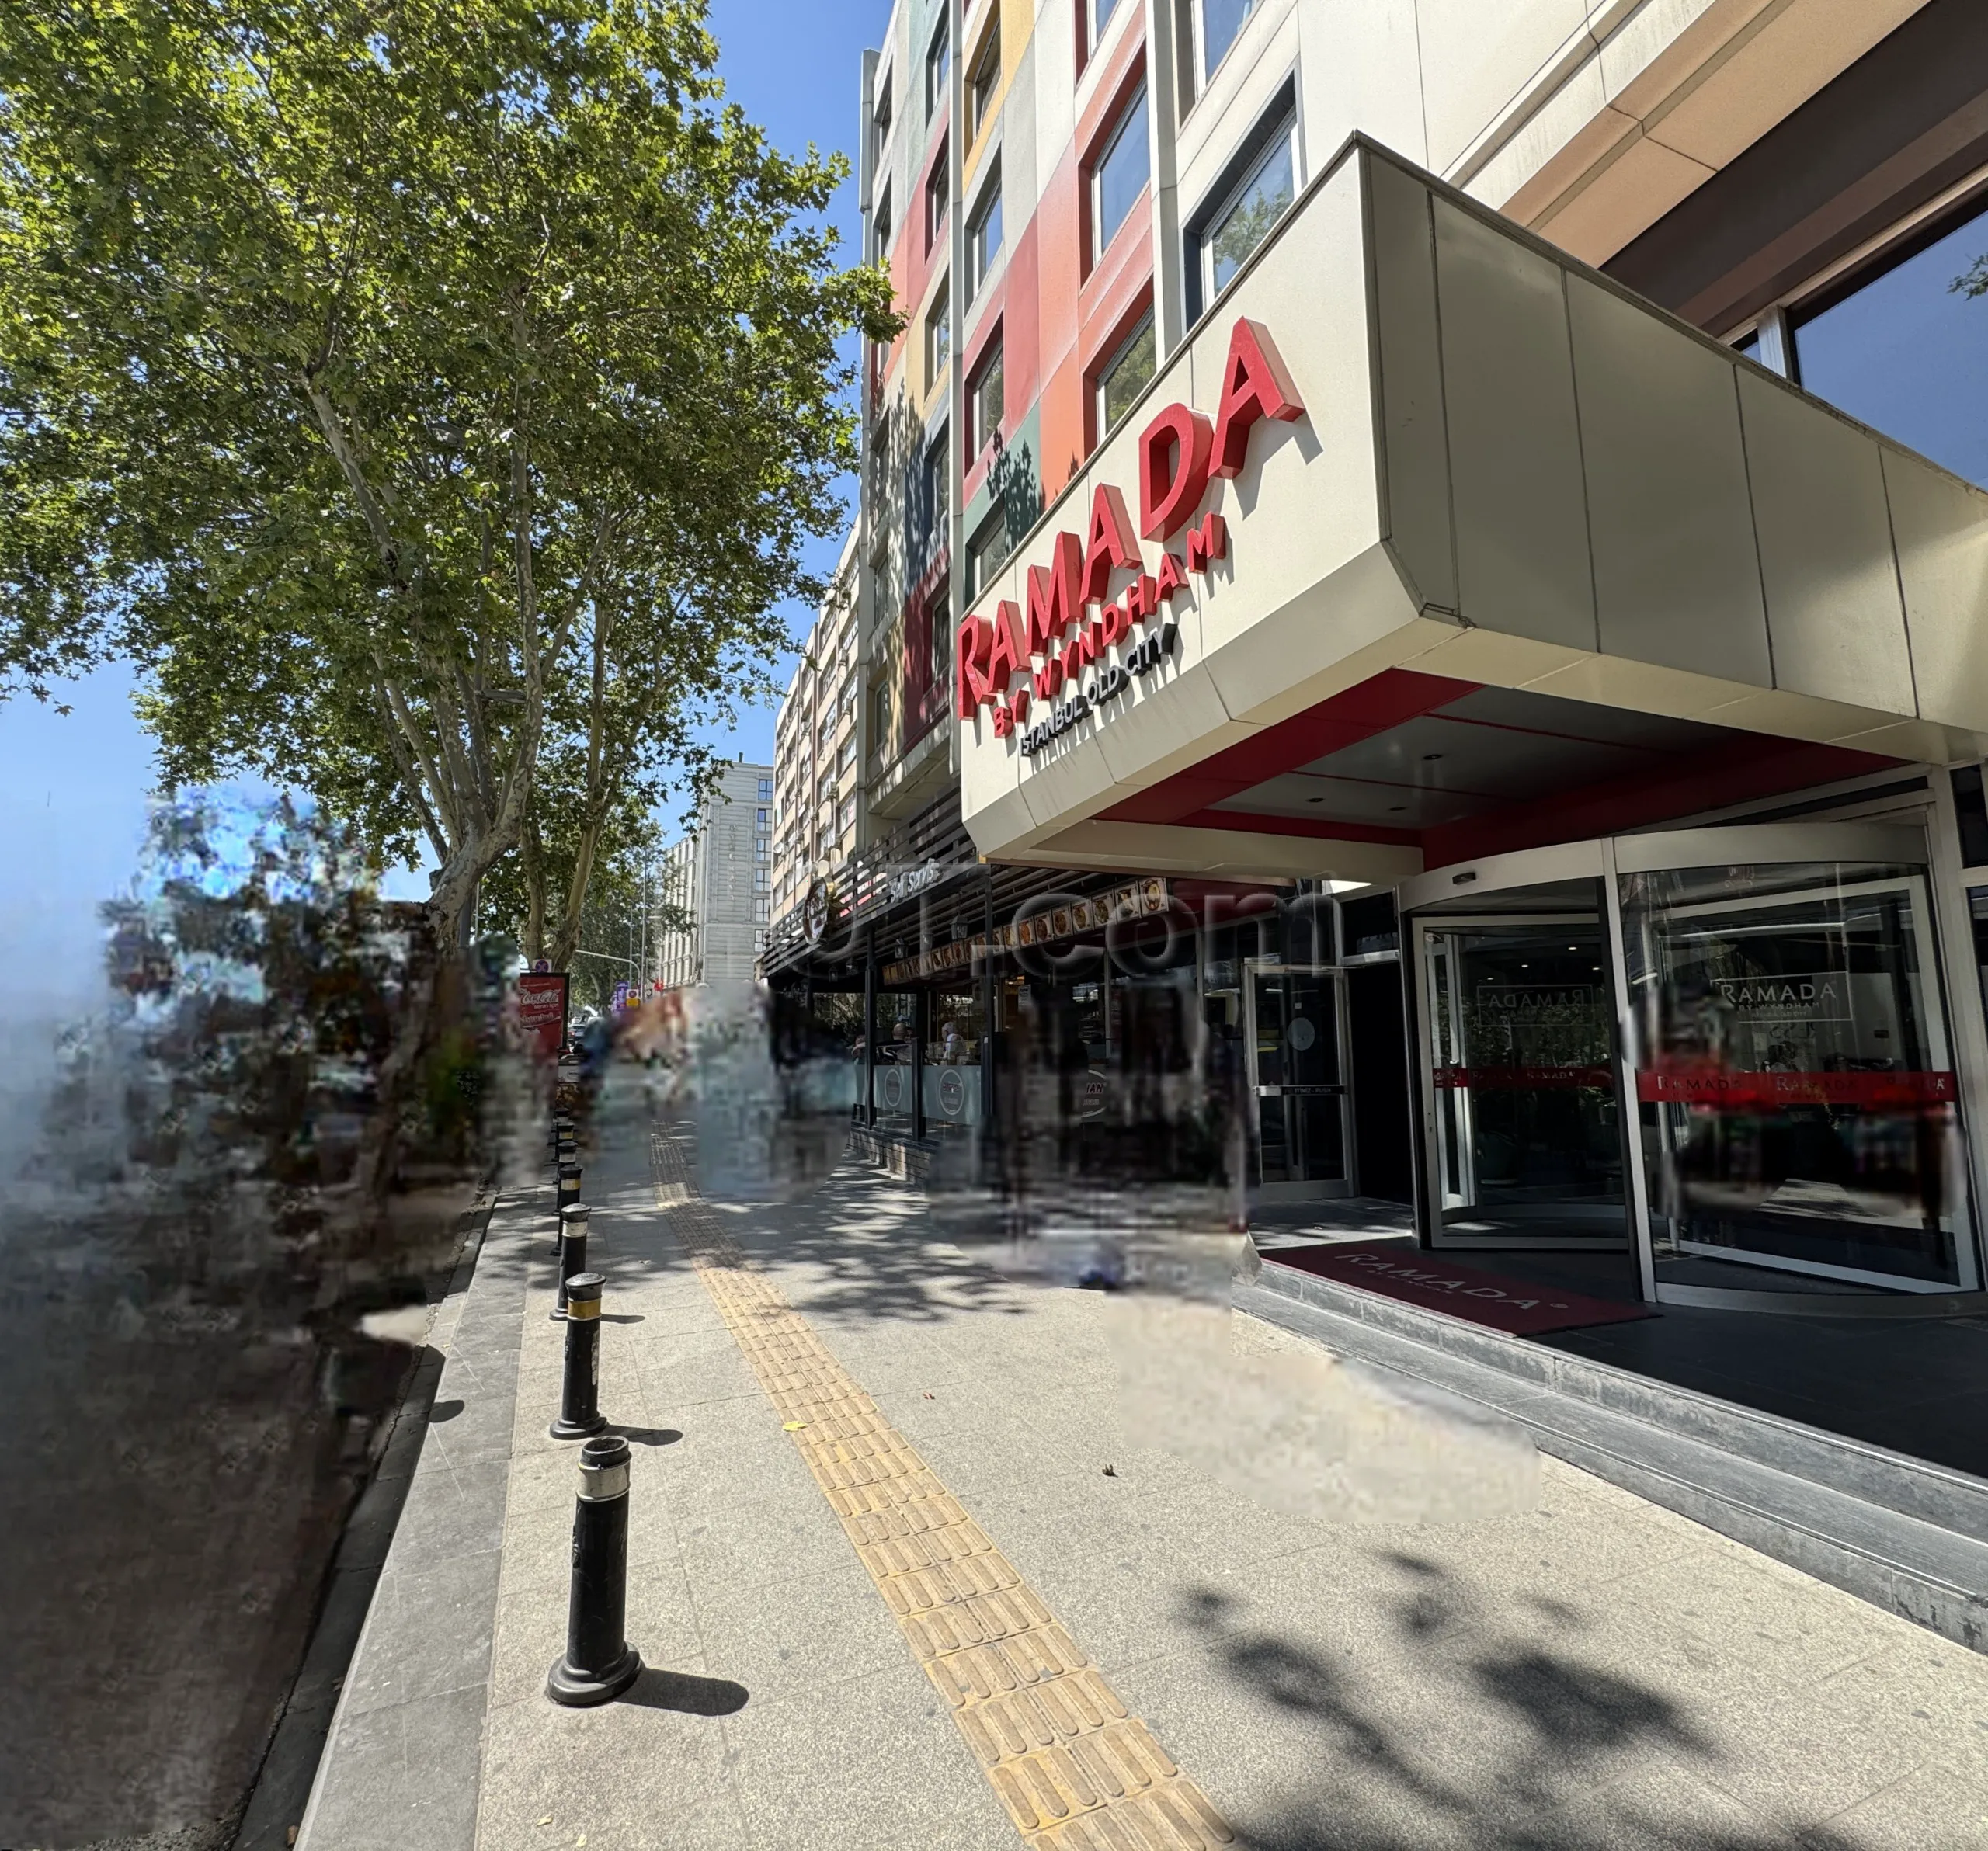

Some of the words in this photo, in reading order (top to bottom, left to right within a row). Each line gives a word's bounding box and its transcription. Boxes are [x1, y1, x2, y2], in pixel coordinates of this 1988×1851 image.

[957, 316, 1305, 721] RAMADA
[993, 689, 1029, 738] BY
[1032, 511, 1225, 702] WYNDHAM
[1087, 665, 1130, 707] OLD
[1124, 623, 1179, 678] CITY
[1720, 981, 1837, 1003] RAMADA
[1334, 1253, 1540, 1310] RAMADA
